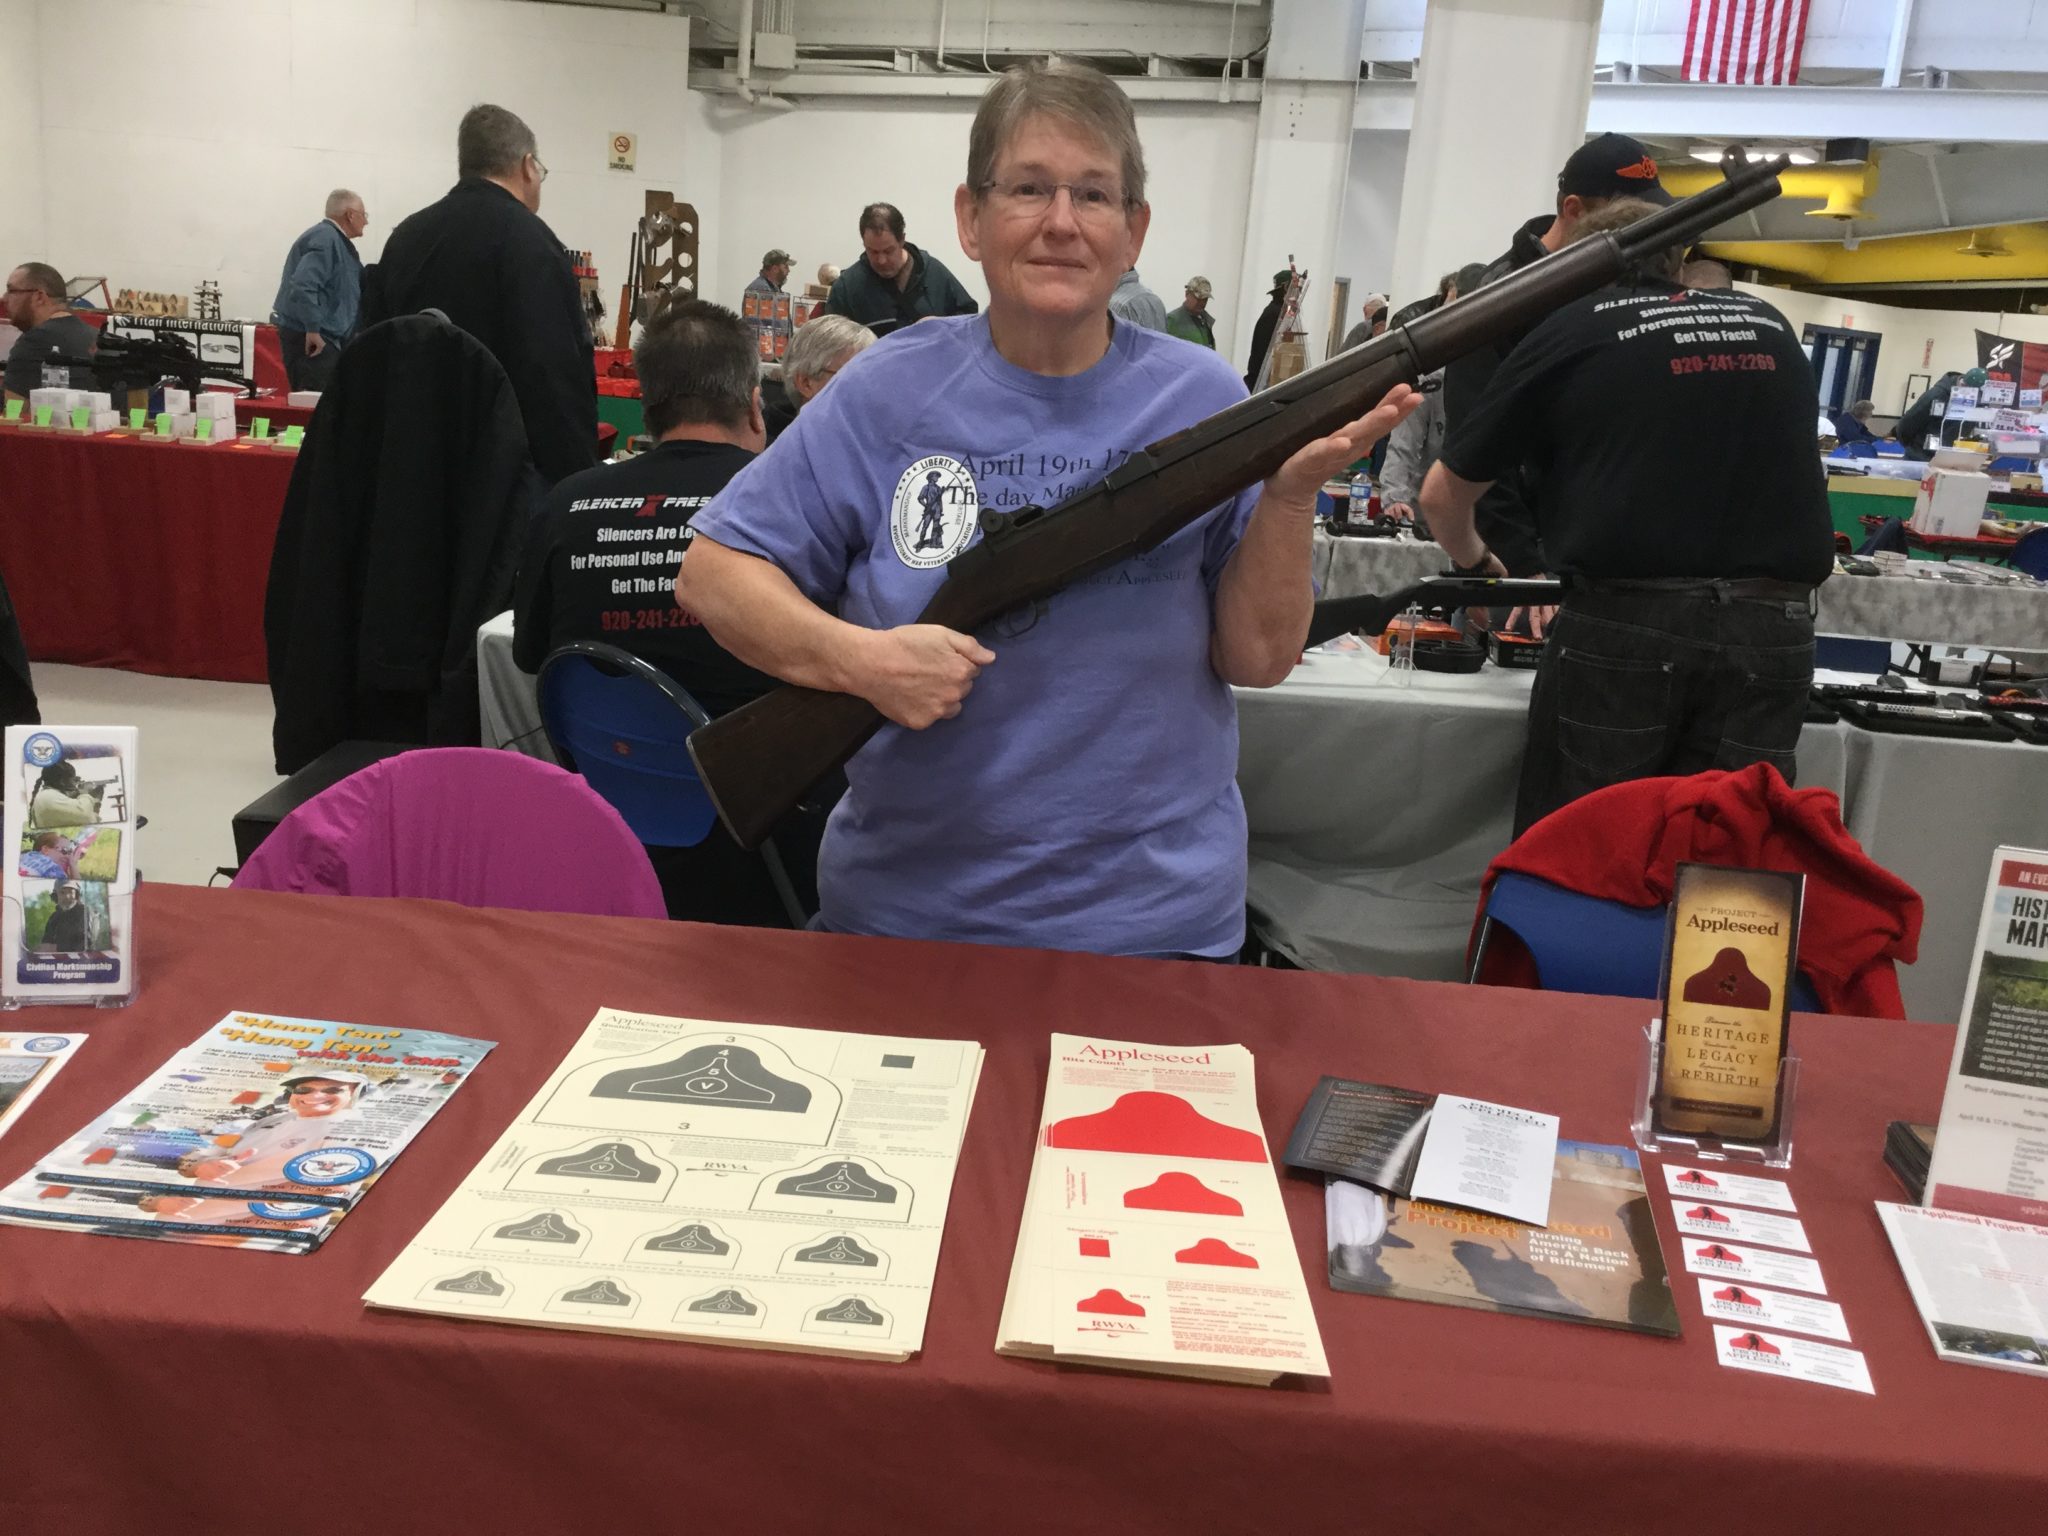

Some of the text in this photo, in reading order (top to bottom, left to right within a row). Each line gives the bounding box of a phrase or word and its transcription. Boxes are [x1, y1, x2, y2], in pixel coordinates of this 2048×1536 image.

[1639, 303, 1699, 319] Silencers
[1699, 302, 1720, 311] Are
[1617, 327, 1638, 342] For
[1640, 314, 1696, 334] Personal
[1697, 313, 1720, 325] Use
[1721, 313, 1744, 324] And
[1673, 328, 1758, 345] Get The Facts!
[1670, 353, 1776, 375] 920-241-2269
[920, 457, 955, 469] LIBERTY
[954, 452, 1025, 481] April
[1039, 454, 1092, 477] 19th
[949, 485, 988, 506] The
[995, 487, 1036, 506] day
[597, 528, 654, 543] Silencers
[655, 526, 677, 541] Are
[571, 555, 586, 570] For
[588, 551, 639, 568] Personal
[641, 551, 664, 565] Use
[611, 578, 632, 594] Get
[634, 577, 656, 592] The
[2018, 871, 2031, 883] AN
[1710, 907, 1758, 919] PROJECT
[1686, 914, 1780, 937] Appleseed
[26, 963, 113, 972] Civilian Marksmanship
[53, 971, 86, 980] Program
[605, 1015, 685, 1031] Appleseed
[1676, 1024, 1769, 1045] HERITAGE
[1062, 1056, 1085, 1064] Hits
[1079, 1044, 1211, 1065] Appleseed
[1687, 1047, 1758, 1065] LEGACY
[708, 1068, 720, 1076] 5
[1681, 1069, 1760, 1087] REBIRTH
[678, 1122, 690, 1130] 3
[703, 1161, 749, 1172] RWVA
[1407, 1210, 1520, 1240] Project
[1922, 1208, 1982, 1226] Appleseed
[1984, 1219, 2026, 1233] Project
[1528, 1230, 1582, 1245] Turning
[1529, 1238, 1629, 1259] America Back
[1530, 1245, 1629, 1267] Into A Nation
[1530, 1254, 1616, 1273] of Riflemen
[1091, 1320, 1137, 1330] RWVA
